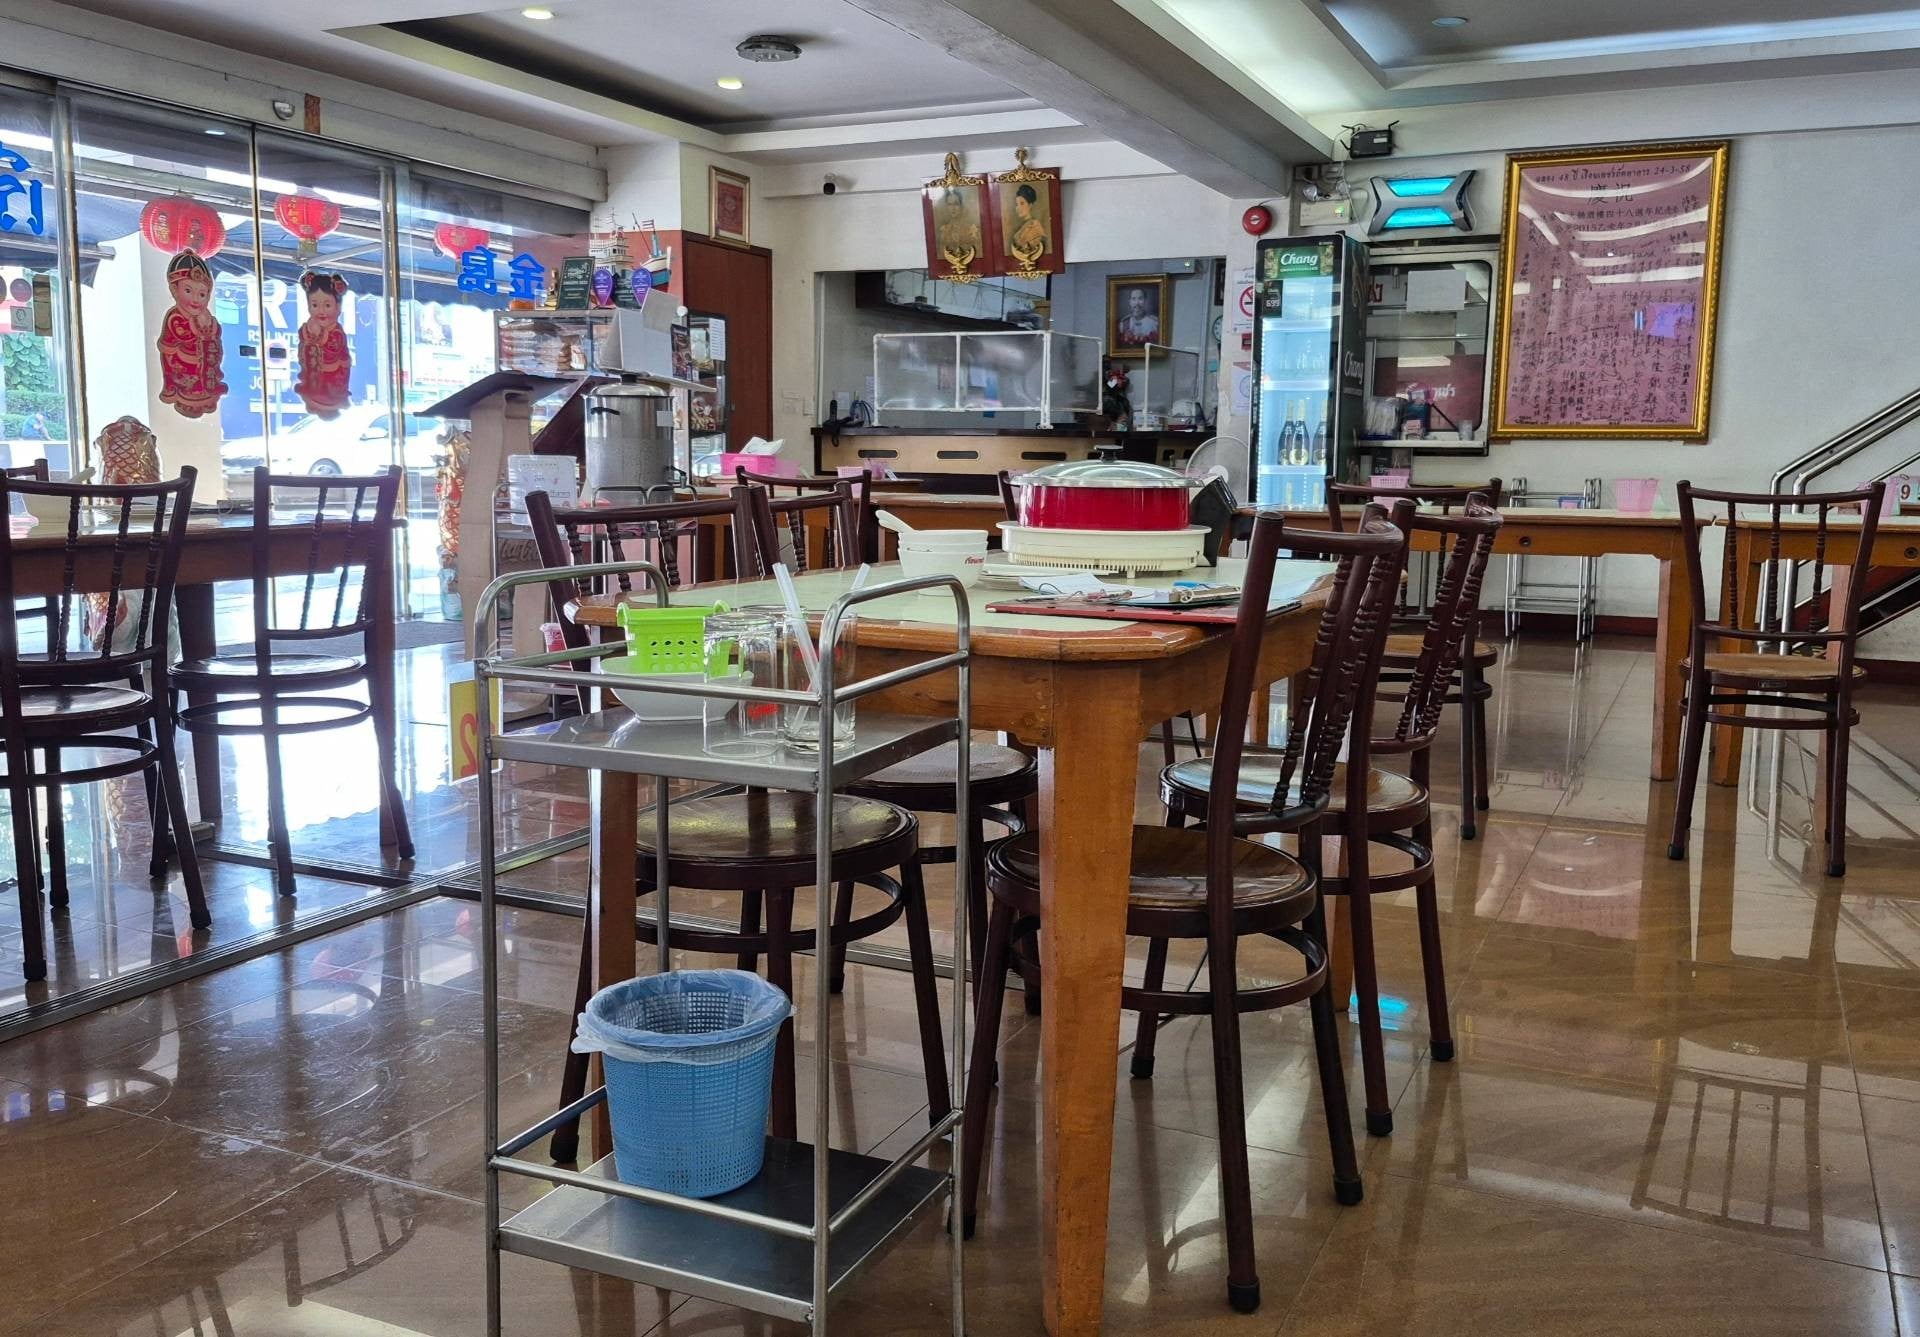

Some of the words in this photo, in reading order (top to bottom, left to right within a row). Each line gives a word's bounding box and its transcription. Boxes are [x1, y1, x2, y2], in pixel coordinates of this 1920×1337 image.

[1281, 253, 1318, 265] Chang
[1344, 351, 1363, 385] Chang
[1901, 484, 1911, 500] 9
